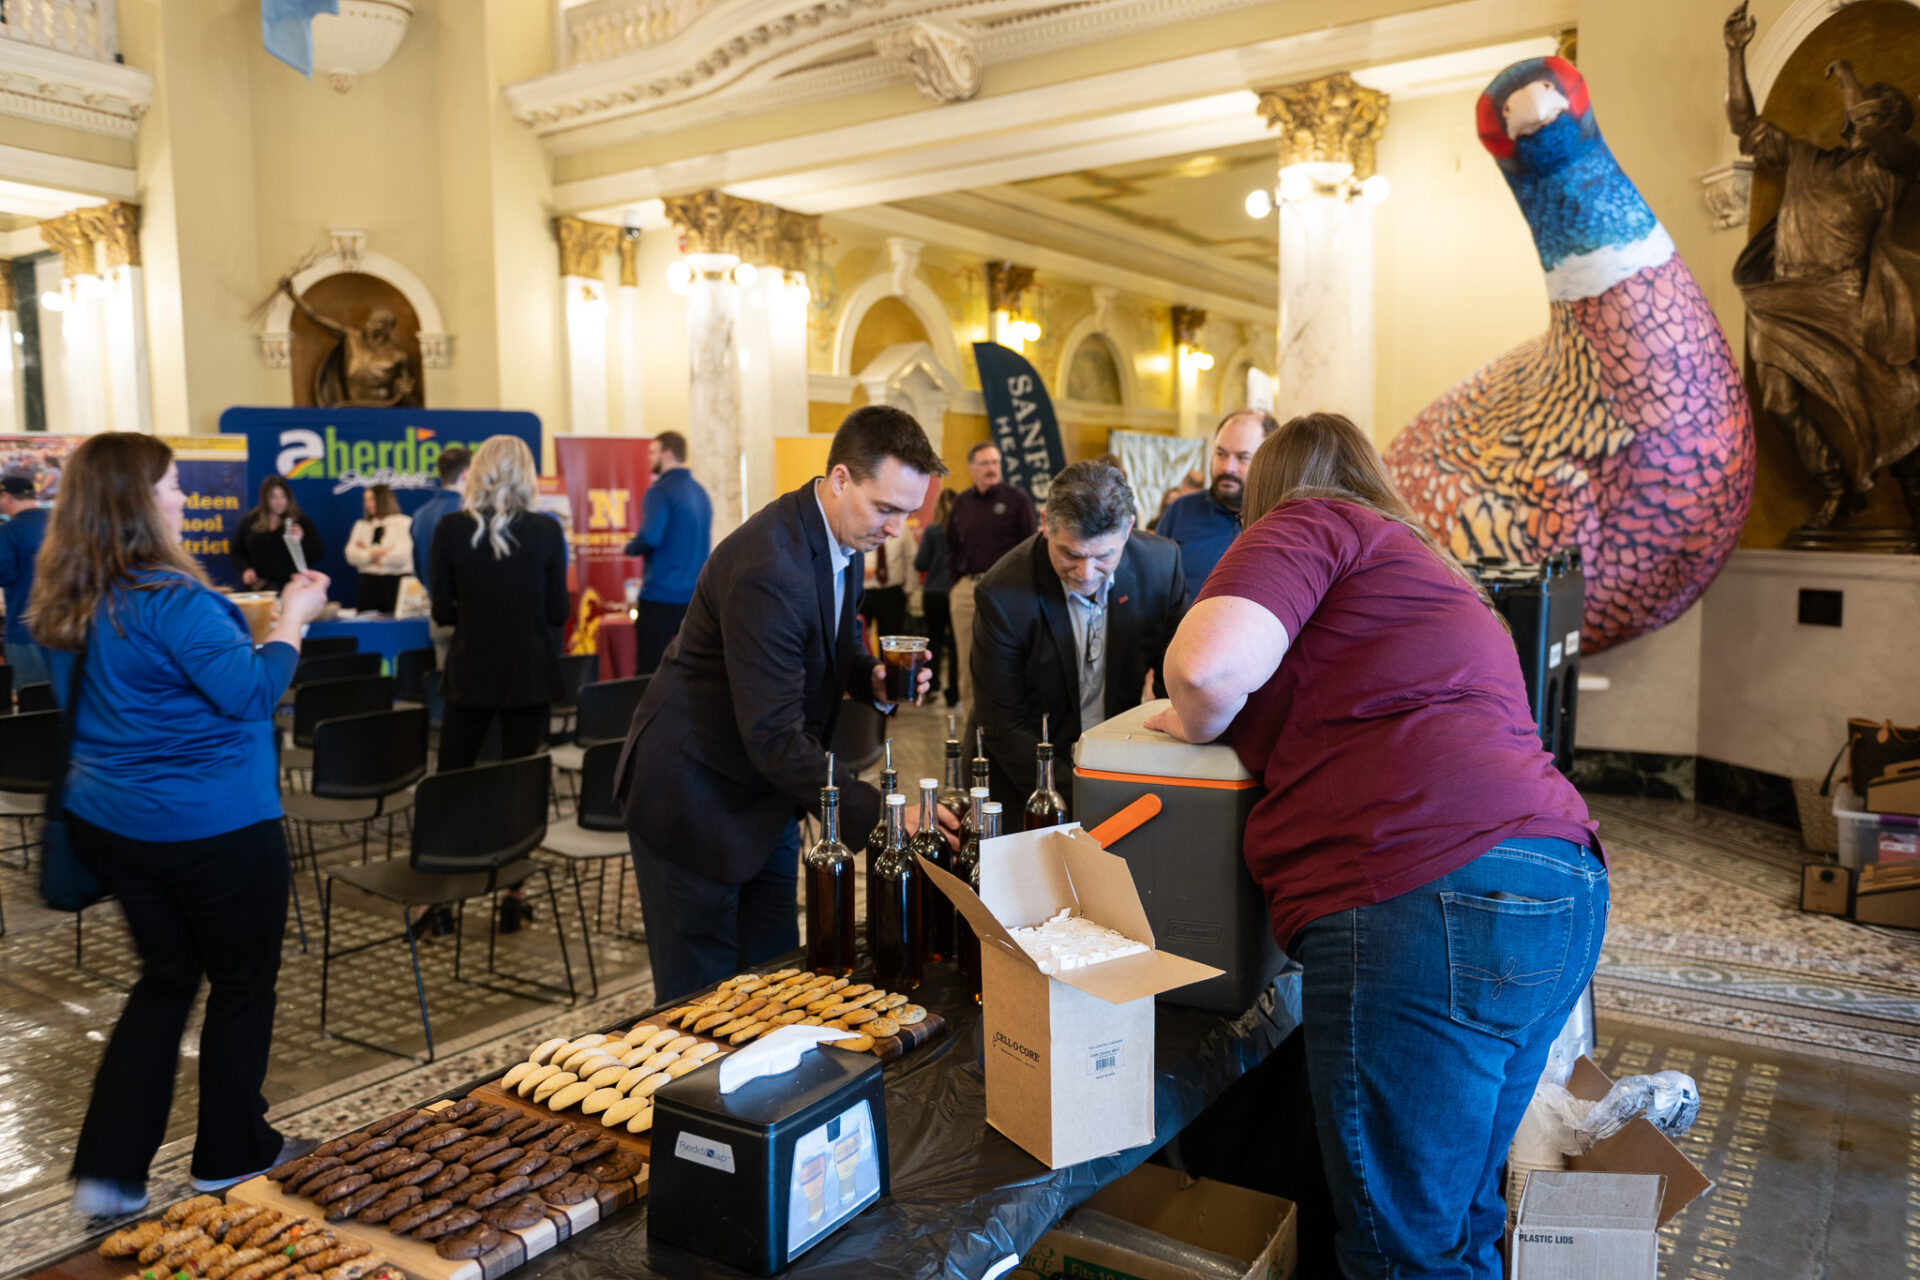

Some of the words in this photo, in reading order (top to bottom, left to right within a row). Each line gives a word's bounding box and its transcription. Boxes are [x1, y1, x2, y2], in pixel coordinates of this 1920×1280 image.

[277, 426, 484, 480] aberde
[1007, 374, 1051, 511] SANFO
[185, 492, 240, 510] deen
[1518, 1233, 1553, 1244] PLASTIC
[1555, 1235, 1574, 1245] LIDS
